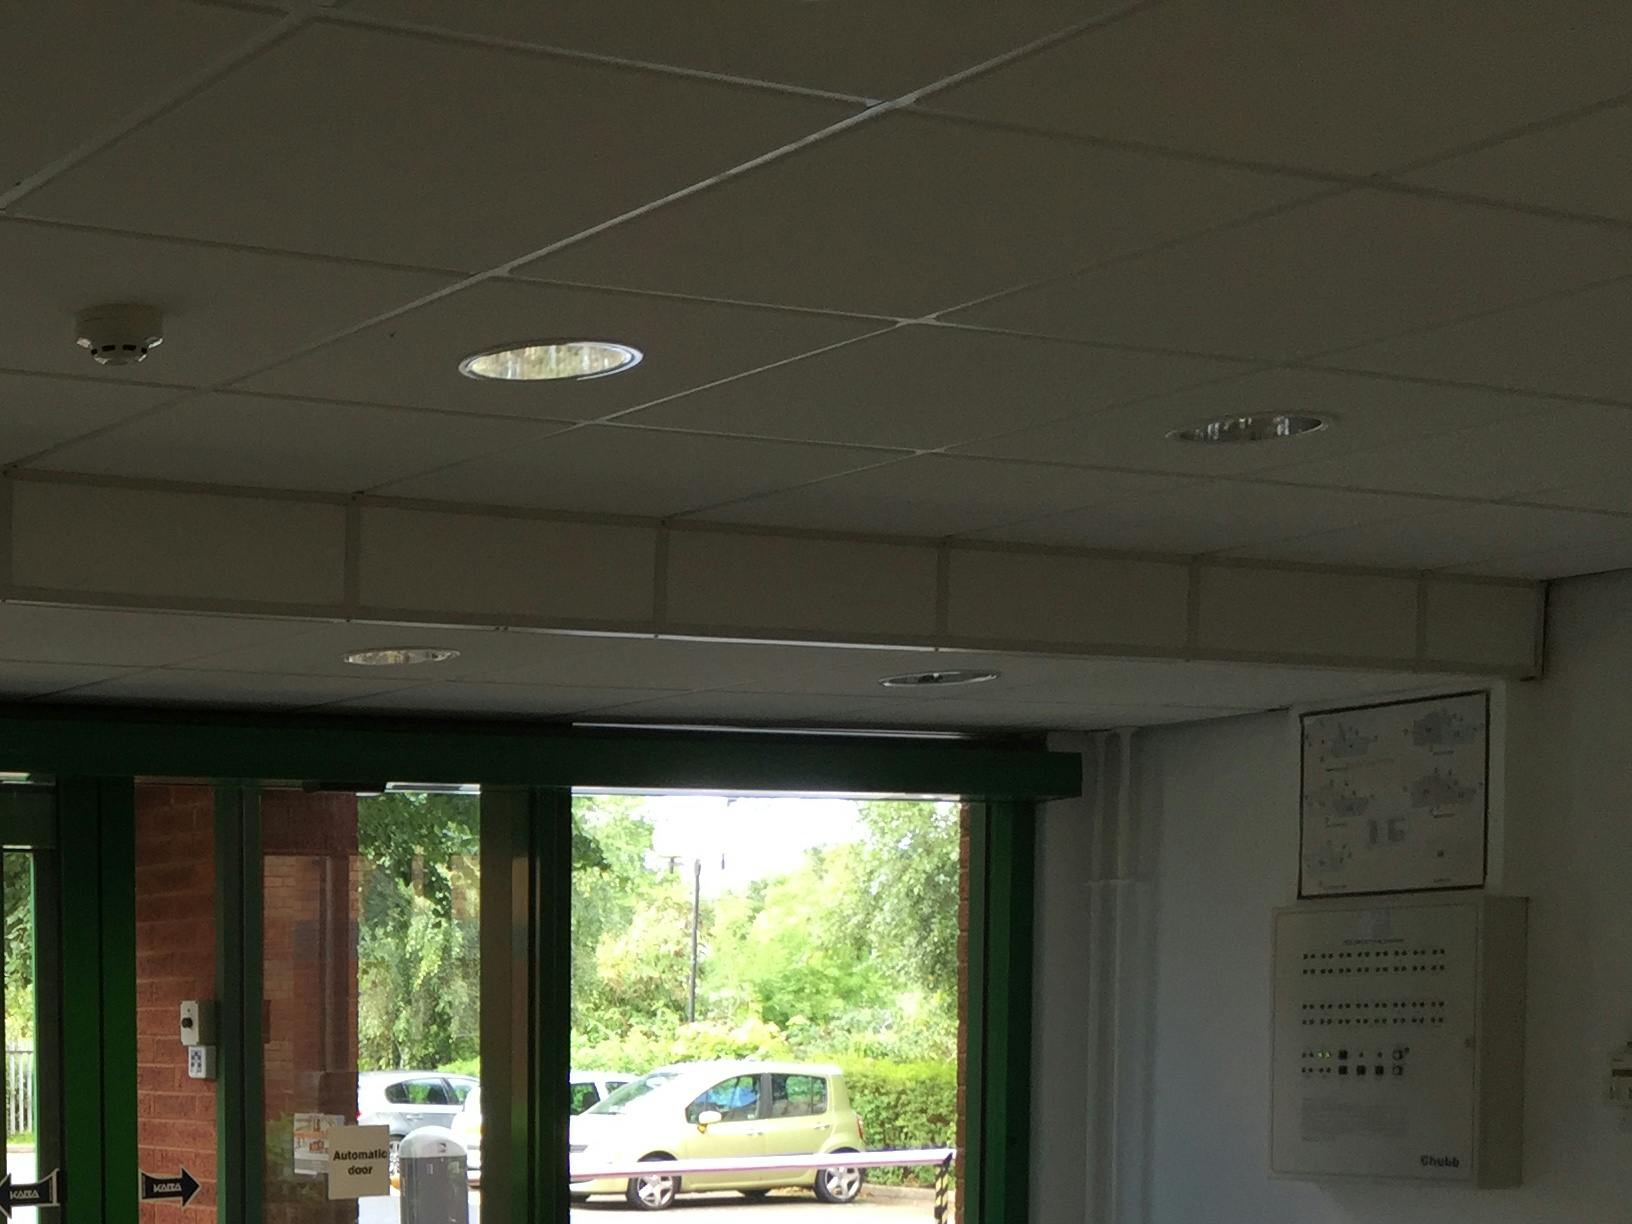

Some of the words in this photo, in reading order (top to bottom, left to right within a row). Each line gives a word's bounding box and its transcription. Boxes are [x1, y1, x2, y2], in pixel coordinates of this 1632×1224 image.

[333, 1149, 387, 1161] Automatic
[1420, 1154, 1460, 1168] Chubb
[347, 1165, 373, 1175] door
